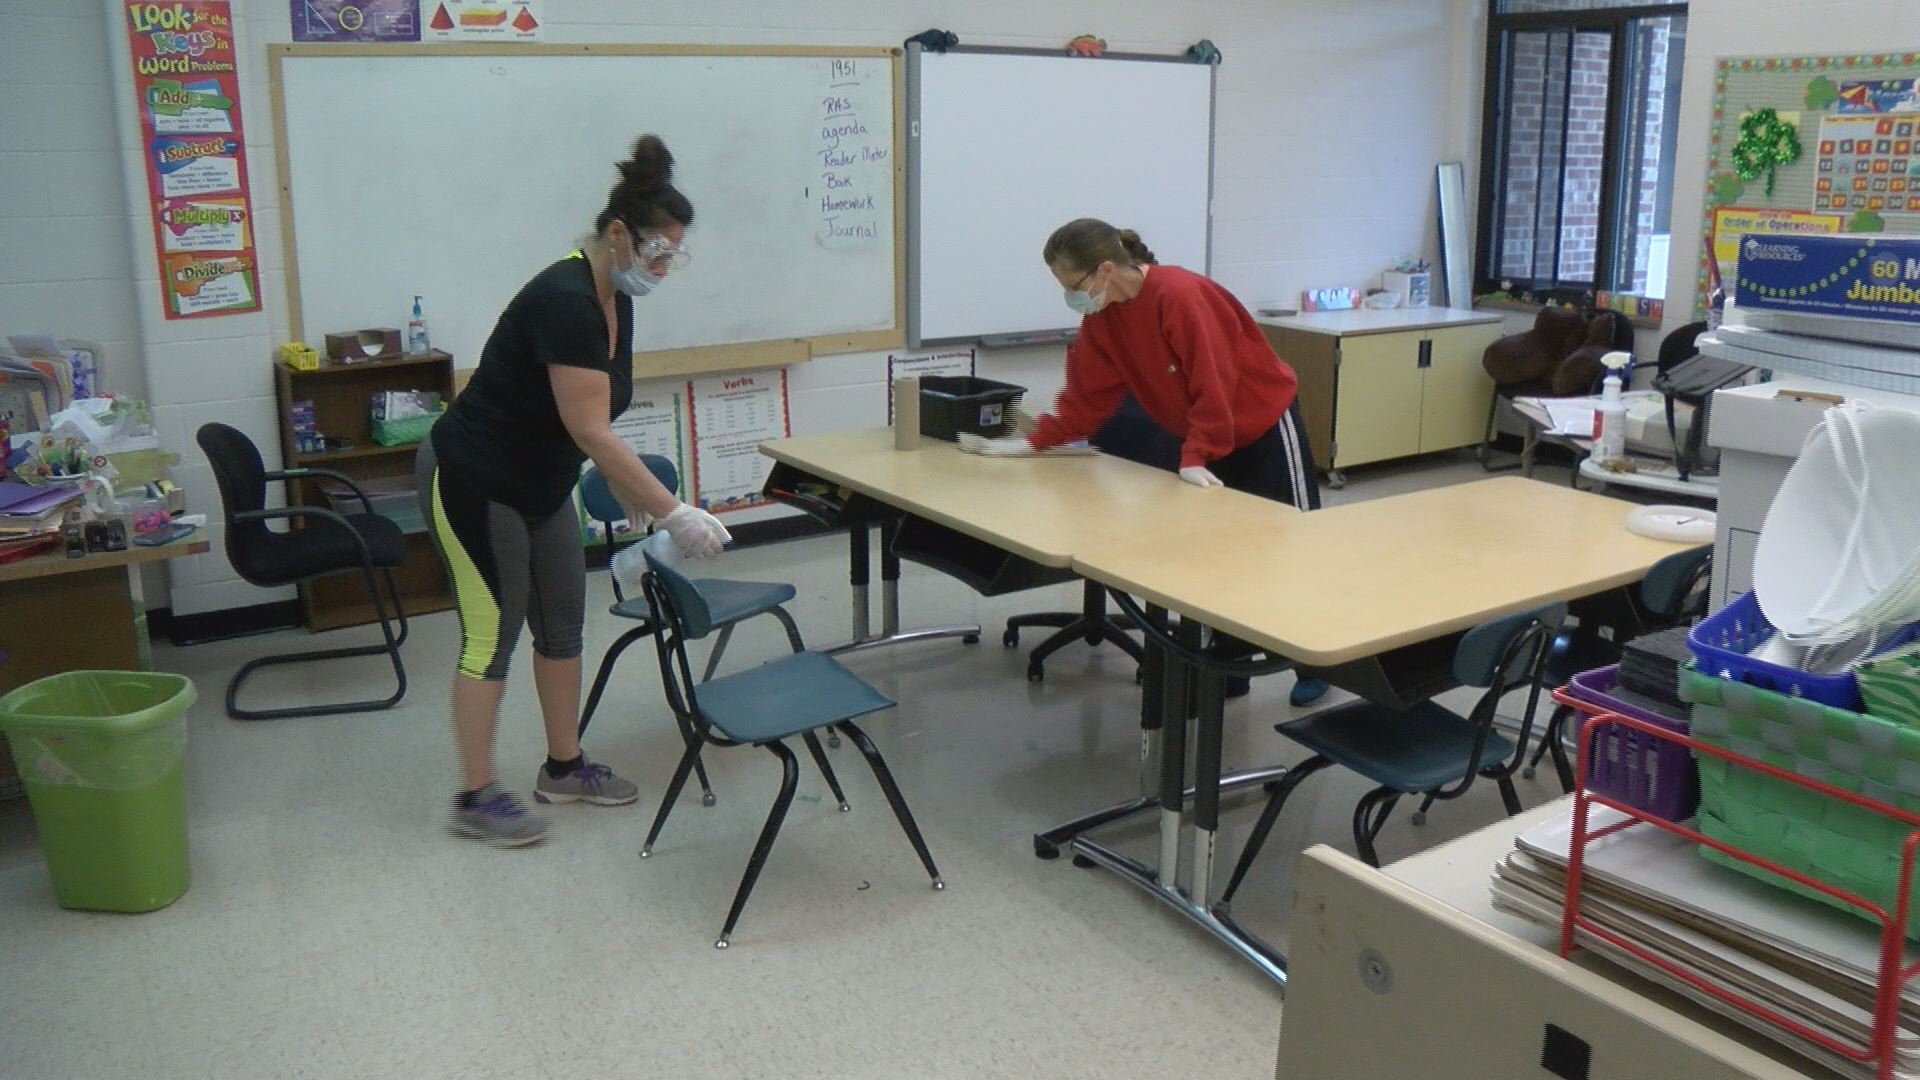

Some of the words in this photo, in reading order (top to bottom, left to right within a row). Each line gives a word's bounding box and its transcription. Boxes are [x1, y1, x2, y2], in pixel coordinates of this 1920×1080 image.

[129, 4, 192, 32] Look
[192, 10, 208, 23] for
[211, 15, 227, 25] the
[150, 30, 216, 56] Keys
[217, 38, 229, 50] in
[191, 61, 233, 72] Problems
[831, 59, 856, 78] 1951
[160, 89, 189, 105] Add
[822, 120, 869, 149] agenda
[166, 137, 226, 162] Subtract
[173, 207, 229, 225] Multiply
[1723, 217, 1750, 227] Order
[1768, 219, 1829, 232] Operations
[822, 215, 877, 239] Journal
[182, 261, 225, 280] Divide
[1871, 260, 1899, 279] 60
[723, 376, 754, 390] Verbs
